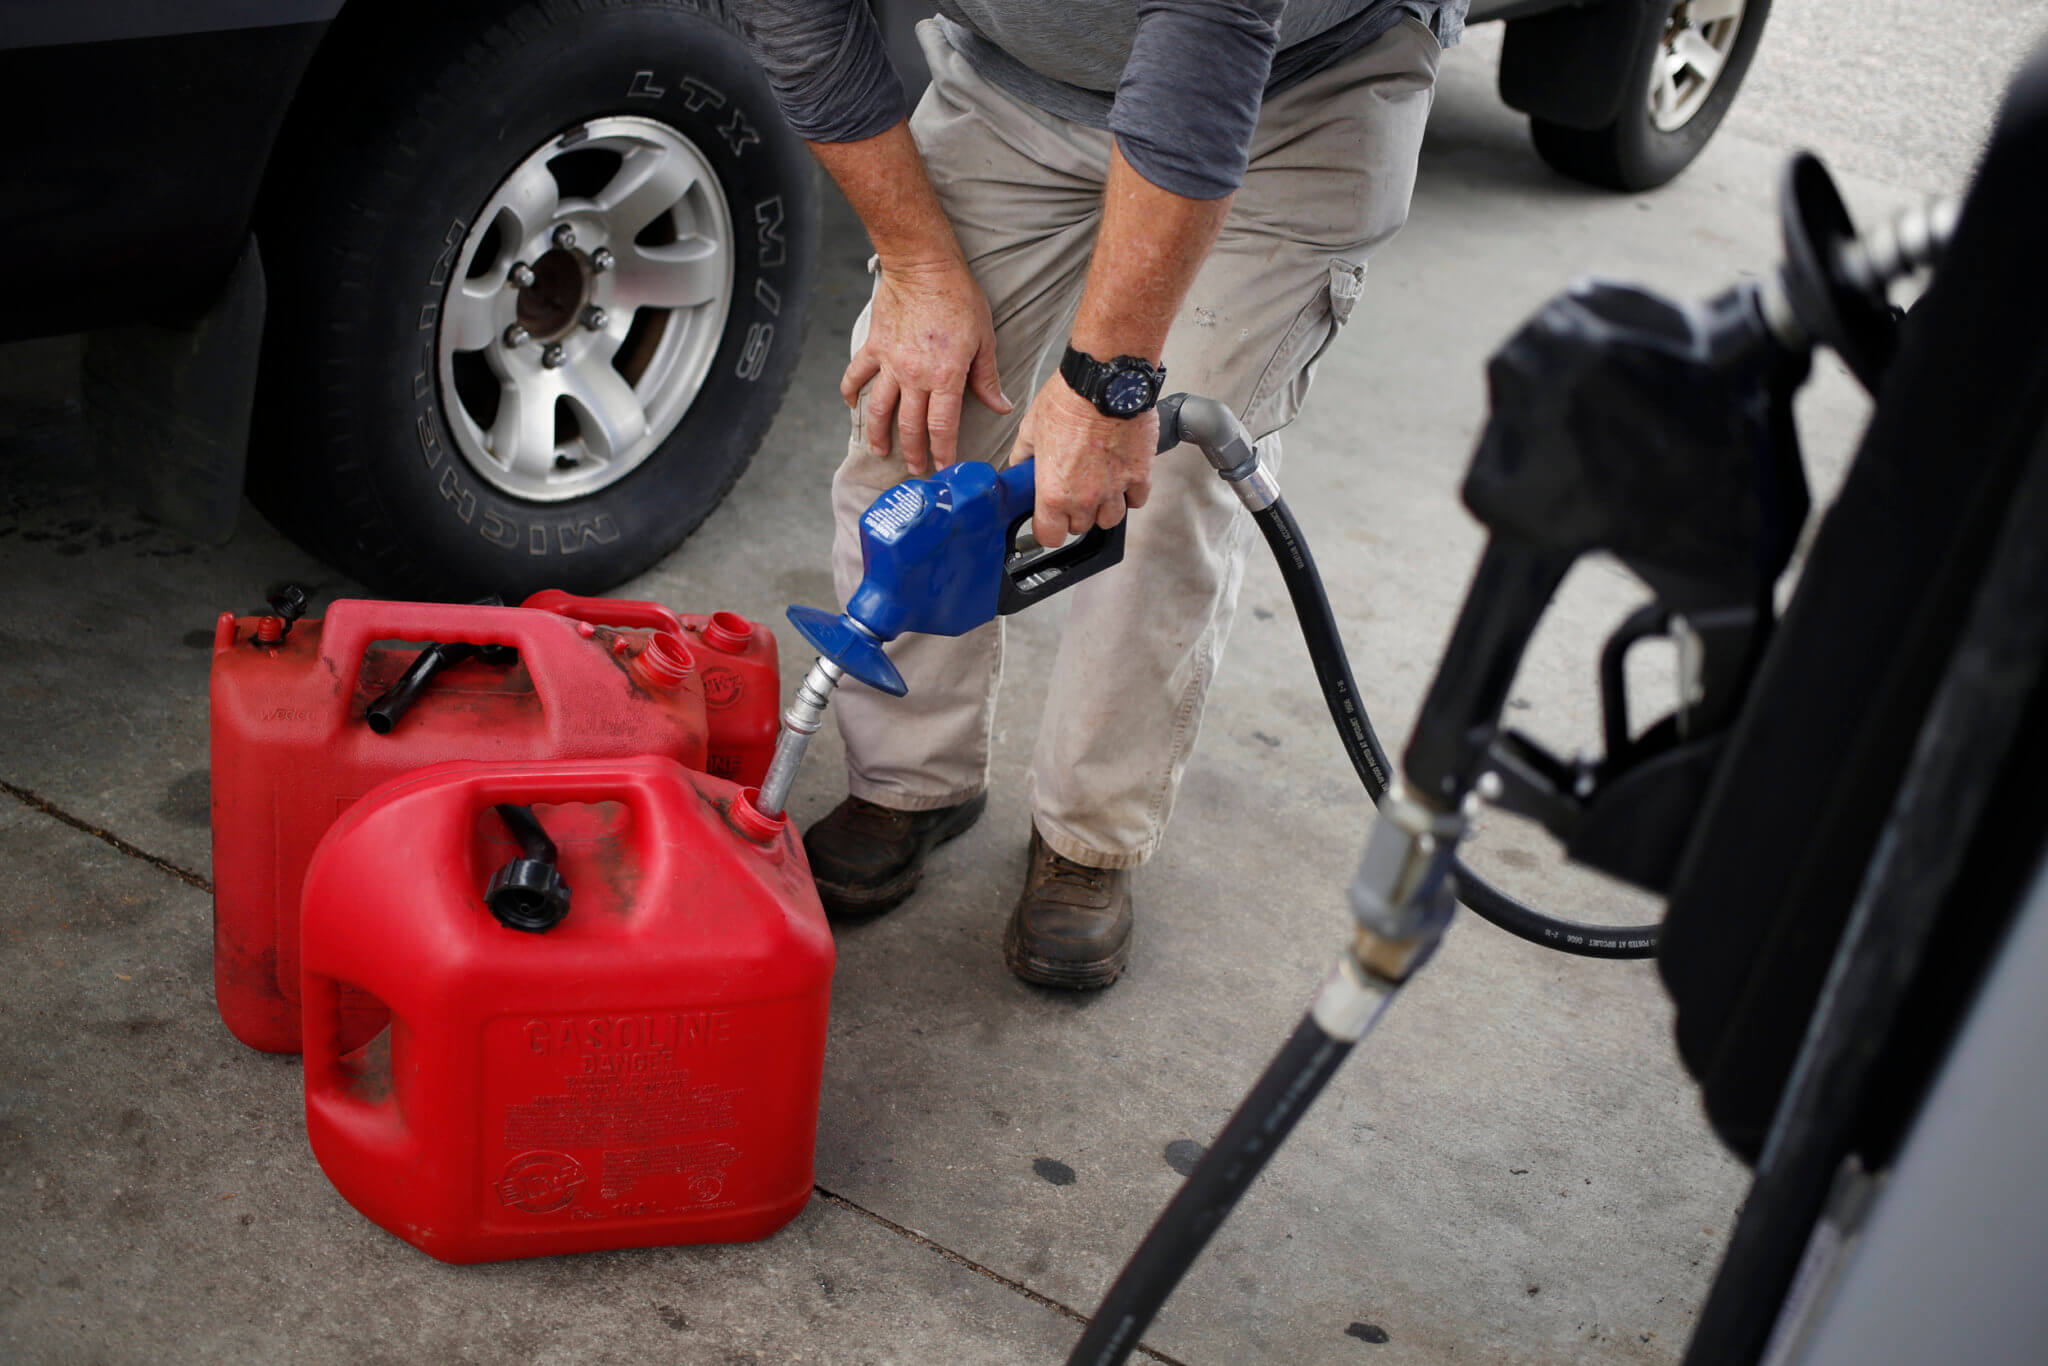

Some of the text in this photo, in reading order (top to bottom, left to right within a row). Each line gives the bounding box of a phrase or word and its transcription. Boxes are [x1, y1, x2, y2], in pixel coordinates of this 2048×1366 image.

[627, 71, 786, 381] LTX M/S
[412, 217, 621, 556] MICHELIN
[522, 1010, 735, 1053] GASOLINE
